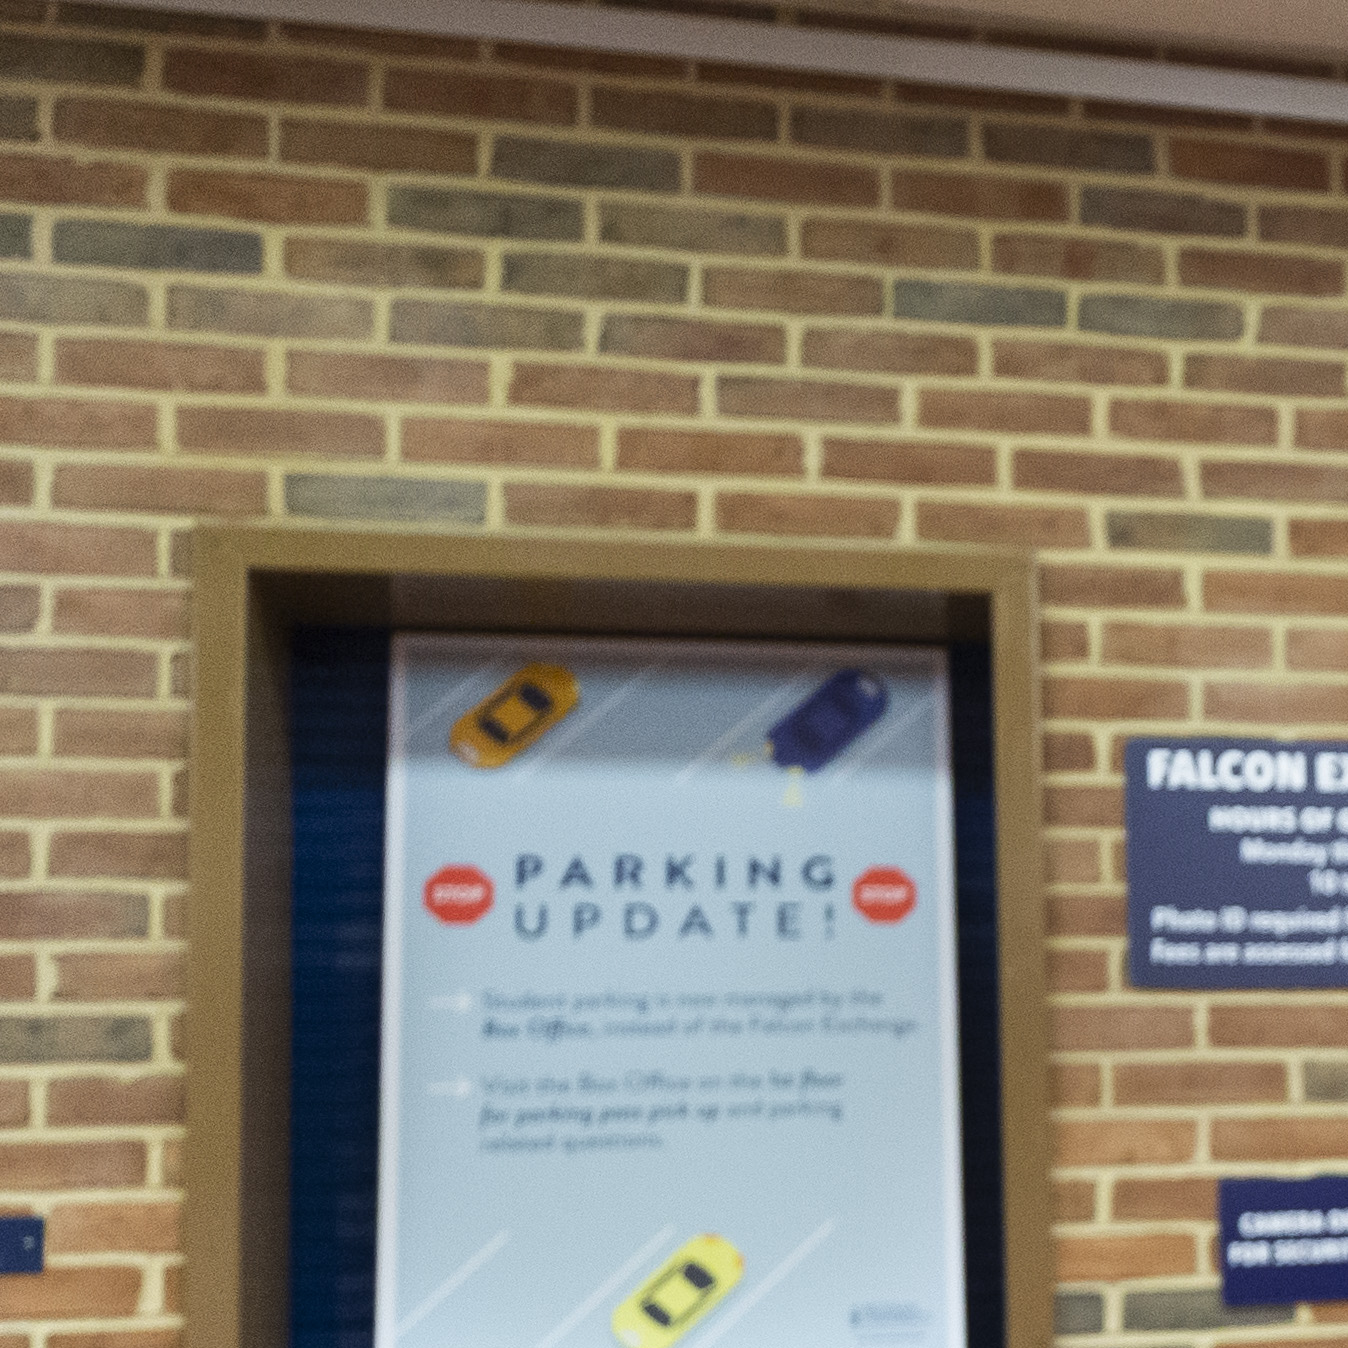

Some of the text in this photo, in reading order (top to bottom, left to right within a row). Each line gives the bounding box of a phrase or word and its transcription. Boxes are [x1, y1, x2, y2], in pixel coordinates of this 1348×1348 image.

[1146, 747, 1308, 793] FALCON
[1207, 804, 1298, 834] HOURS
[1299, 806, 1334, 834] OF
[1238, 836, 1329, 868] Monday
[514, 853, 838, 892] PARKING
[1307, 868, 1337, 898] 10
[513, 900, 838, 942] UPDATE!
[1150, 904, 1218, 935] Photo
[1219, 905, 1248, 935] ID
[1249, 905, 1341, 938] required
[1149, 936, 1201, 966] Fees
[1203, 940, 1240, 966] are
[1242, 936, 1338, 967] assessed
[571, 989, 651, 1015] parking
[481, 1017, 520, 1040] Box
[748, 1015, 816, 1036] Falcon
[514, 1102, 595, 1128] parking
[767, 1099, 844, 1125] parking
[1237, 1208, 1325, 1240] CAMERA
[1227, 1239, 1270, 1269] FOR
